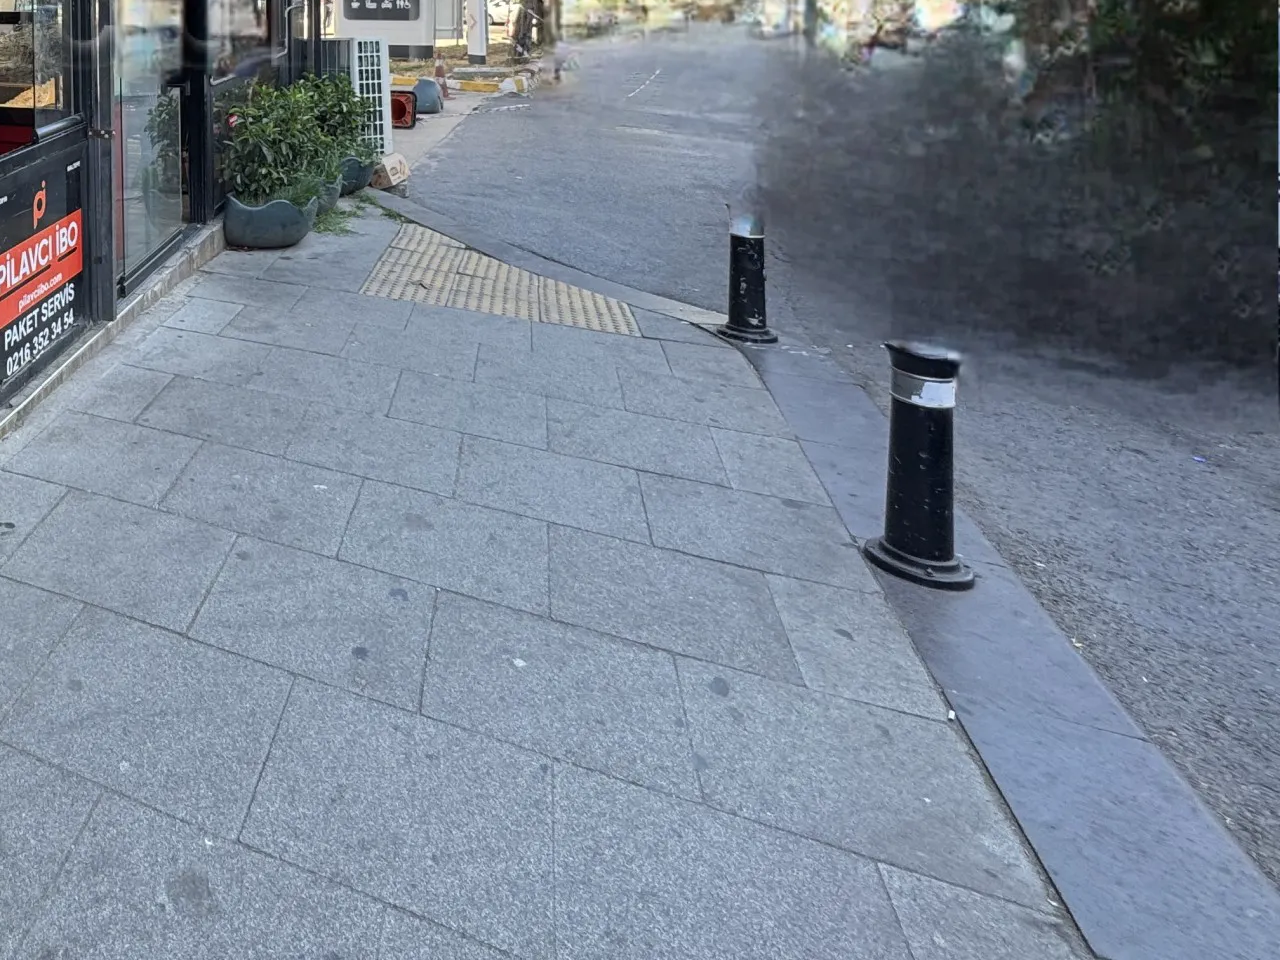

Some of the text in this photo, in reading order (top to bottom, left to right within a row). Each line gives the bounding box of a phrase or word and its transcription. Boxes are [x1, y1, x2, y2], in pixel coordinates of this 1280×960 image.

[55, 221, 79, 257] İBO
[4, 282, 75, 351] PAKET SERVİS
[32, 330, 50, 356] 352
[51, 323, 62, 340] 34
[63, 308, 75, 327] 54
